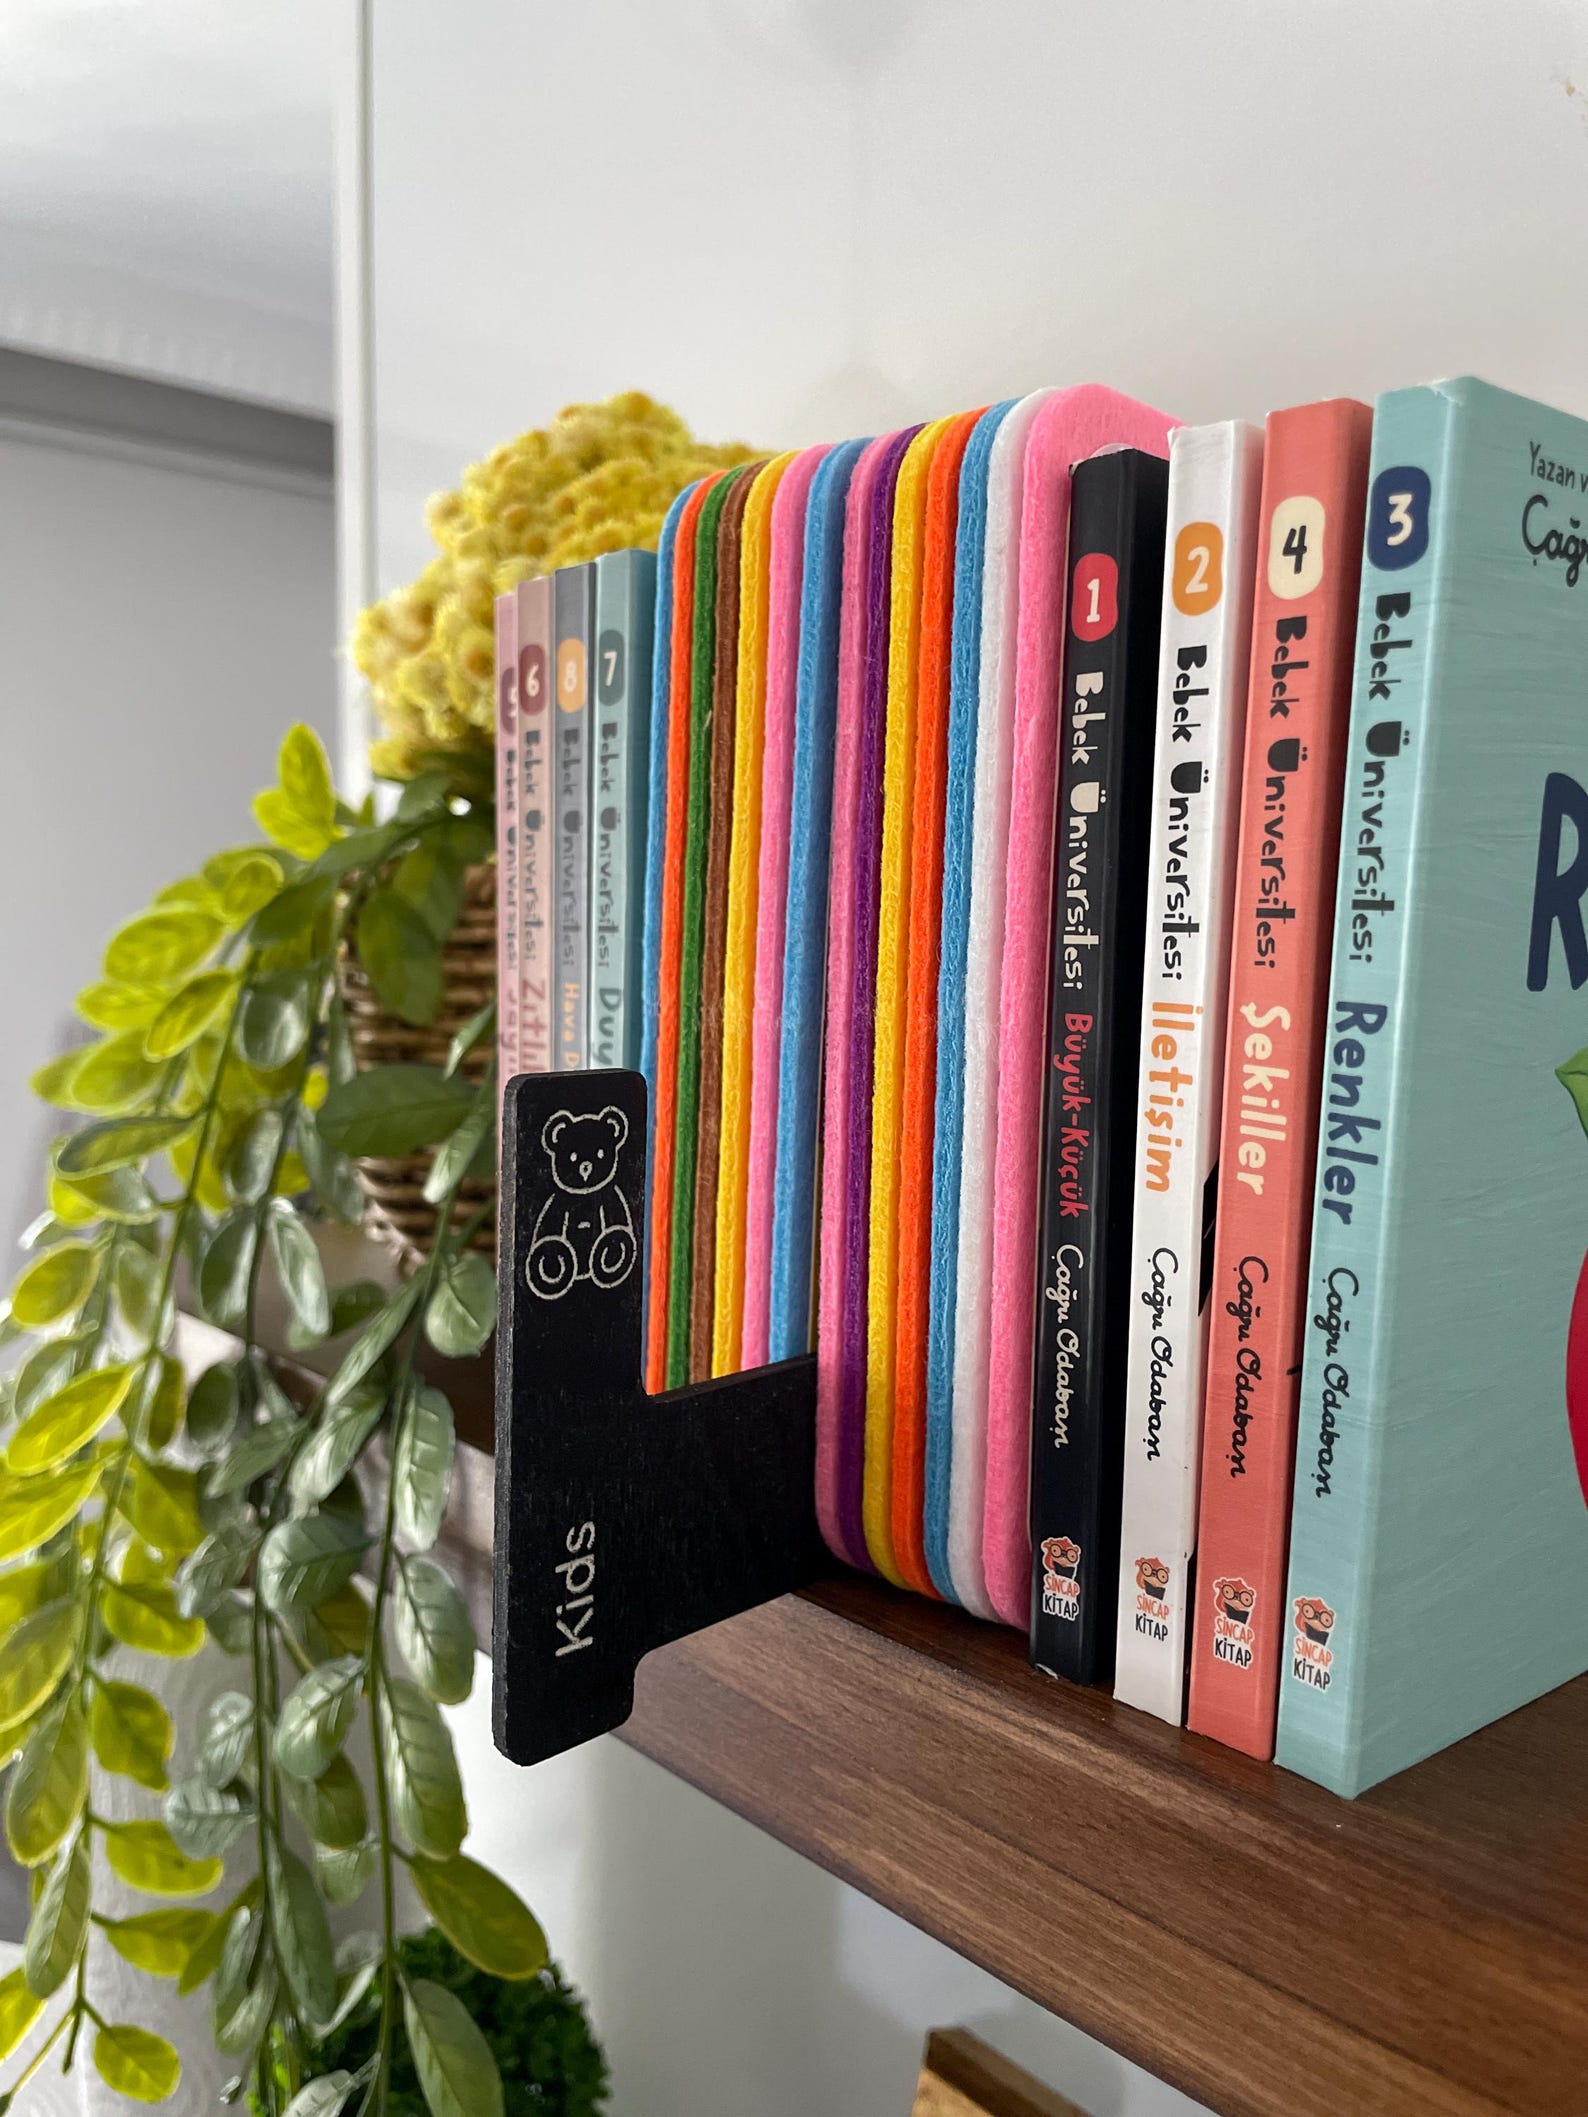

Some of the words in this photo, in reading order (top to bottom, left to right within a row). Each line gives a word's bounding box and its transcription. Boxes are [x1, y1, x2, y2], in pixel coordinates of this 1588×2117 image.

[1529, 440, 1575, 489] Yazan
[1282, 525, 1307, 574] 4
[1386, 491, 1413, 547] 3
[1086, 578, 1101, 623] 1
[1186, 546, 1210, 594] 2
[563, 660, 577, 693] 8
[603, 651, 617, 687] 7
[1271, 615, 1309, 720] Bebek
[1369, 591, 1412, 701] Bebek
[525, 663, 540, 697] 6
[1172, 644, 1209, 743] Bebek
[1072, 671, 1106, 766] Bebek
[524, 729, 542, 796] Bebek
[563, 728, 582, 797] Bebek
[601, 722, 620, 793] Bebek
[1162, 761, 1209, 981] Üniversitesi
[1254, 737, 1308, 970] Üniversitesi
[1349, 720, 1410, 964] Üniversitesi
[598, 806, 622, 969] Üniversitesi
[1062, 780, 1107, 991] Üniversitesi
[1053, 1012, 1094, 1219] Büyük-Küçük
[1144, 1002, 1203, 1193] İletişim
[1237, 1001, 1291, 1196] Şekiller
[1321, 1001, 1388, 1226] Renkler
[554, 1520, 596, 1658] Kids
[1044, 1592, 1078, 1619] KİTAP
[1045, 1573, 1079, 1598] SİNCAP
[1136, 1593, 1170, 1620] SİNCAP
[1135, 1613, 1168, 1641] KİTAP
[1215, 1637, 1252, 1667] KİTAP
[1216, 1615, 1254, 1644] SİNCAP
[1295, 1636, 1333, 1667] SİNCAP
[1293, 1658, 1331, 1690] KİTAP
